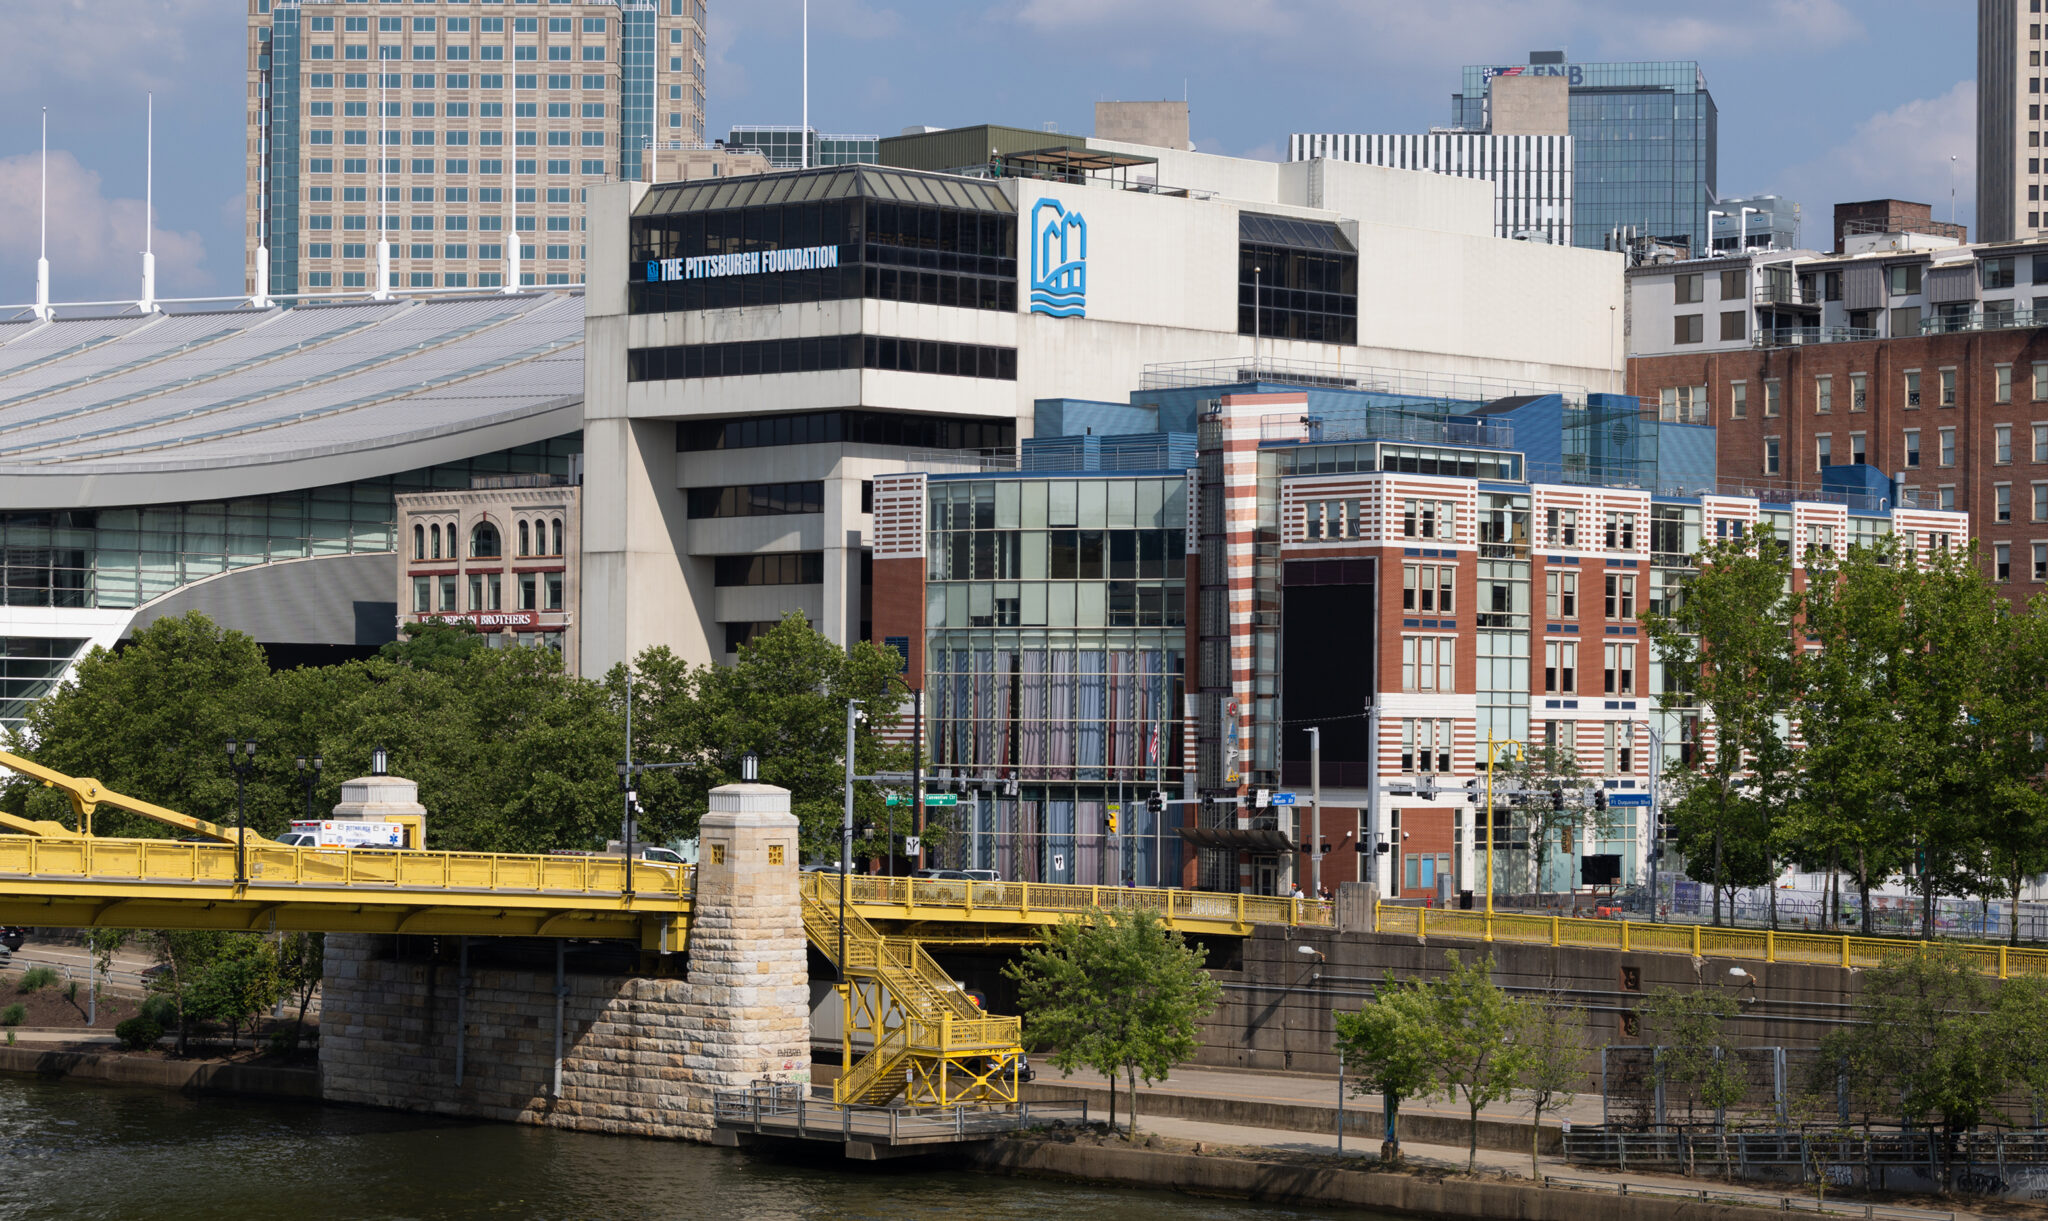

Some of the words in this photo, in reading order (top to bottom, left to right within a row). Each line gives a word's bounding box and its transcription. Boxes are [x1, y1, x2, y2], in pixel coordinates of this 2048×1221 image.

[660, 257, 684, 282] THE
[685, 251, 760, 279] PITTSBURGH
[762, 246, 838, 274] FOUNDATION
[480, 614, 531, 626] BROTHERS
